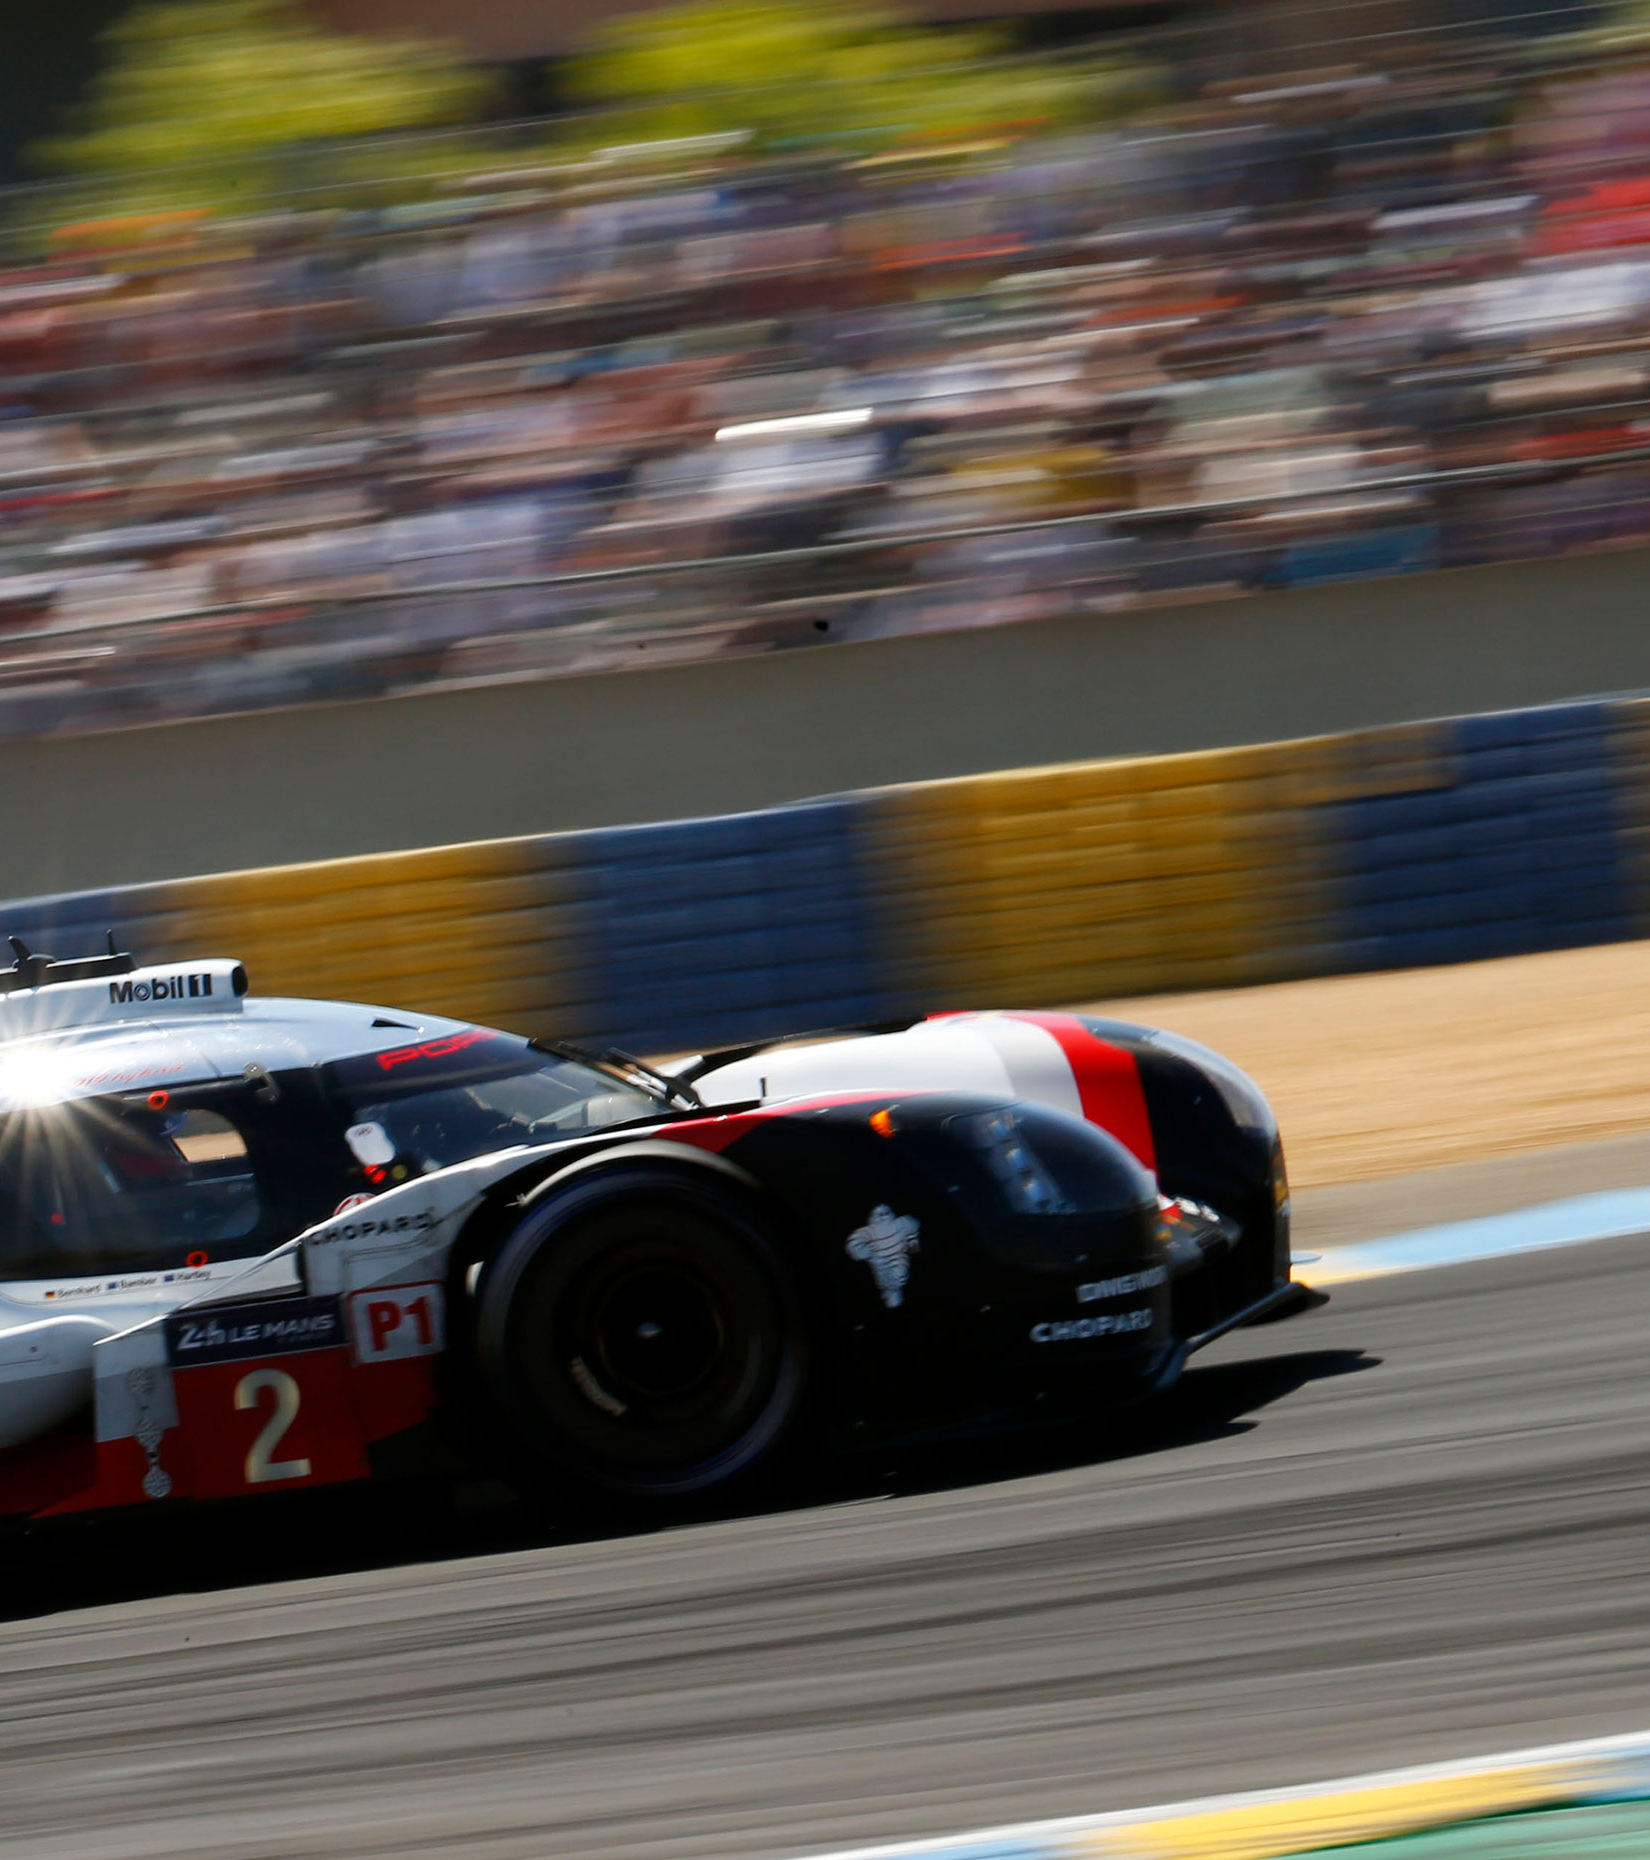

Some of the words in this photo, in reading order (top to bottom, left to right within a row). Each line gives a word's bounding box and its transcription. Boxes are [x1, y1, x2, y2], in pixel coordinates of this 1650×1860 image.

[109, 976, 184, 1004] Mobil
[188, 974, 212, 997] 1
[304, 1212, 431, 1246] CHOPARD
[228, 1324, 261, 1343] LE
[261, 1313, 335, 1339] MANS
[367, 1295, 435, 1353] P1
[1030, 1308, 1153, 1343] CHOPARD
[233, 1368, 312, 1485] 2
